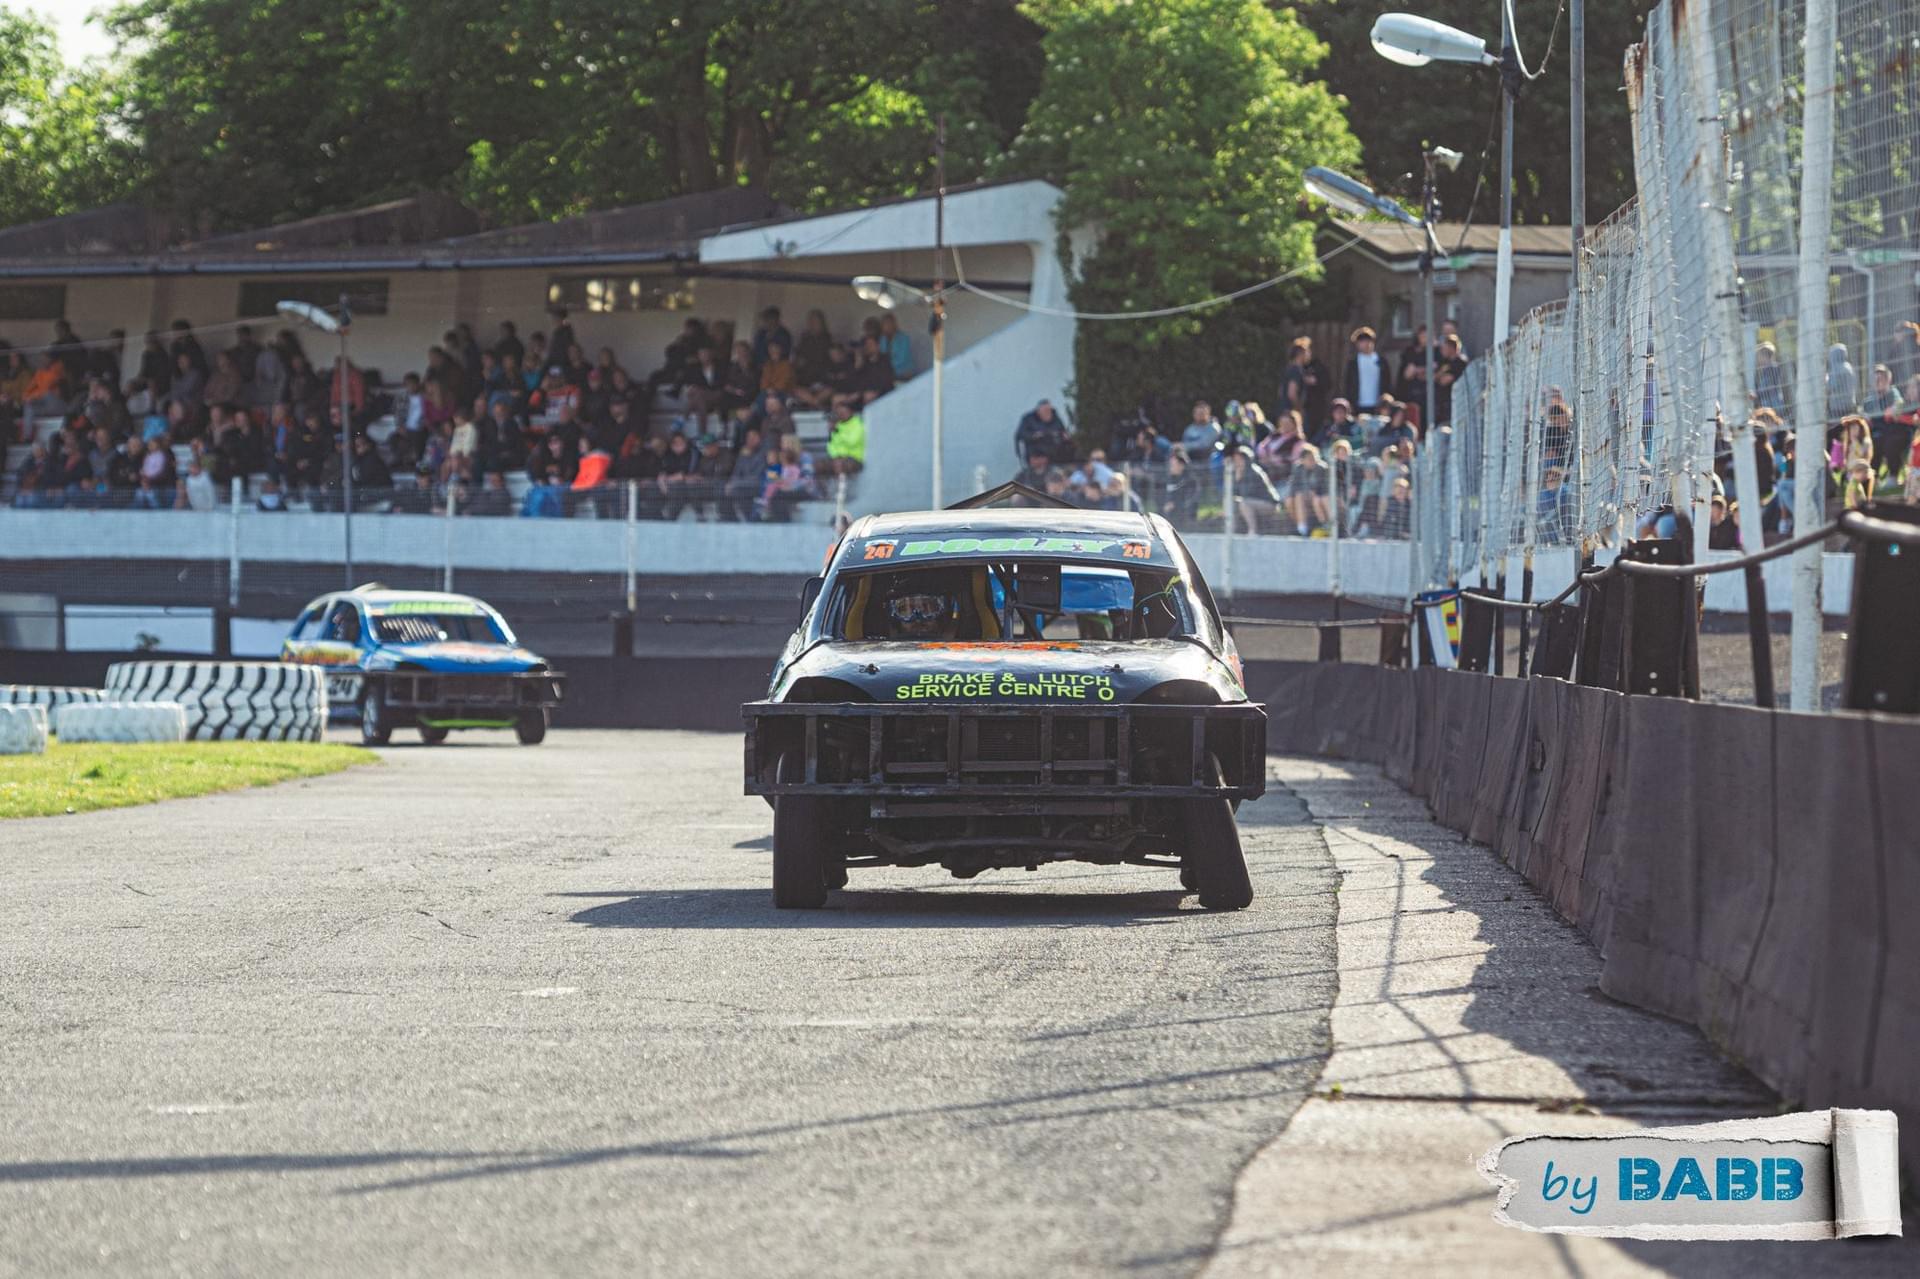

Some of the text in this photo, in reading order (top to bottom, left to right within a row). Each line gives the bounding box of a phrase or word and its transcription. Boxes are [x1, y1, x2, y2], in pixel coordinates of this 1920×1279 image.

[864, 543, 895, 560] 247
[919, 673, 995, 684] BRAKE
[1001, 672, 1017, 683] &
[896, 683, 992, 700] SERVICE
[998, 683, 1086, 698] CENTRE
